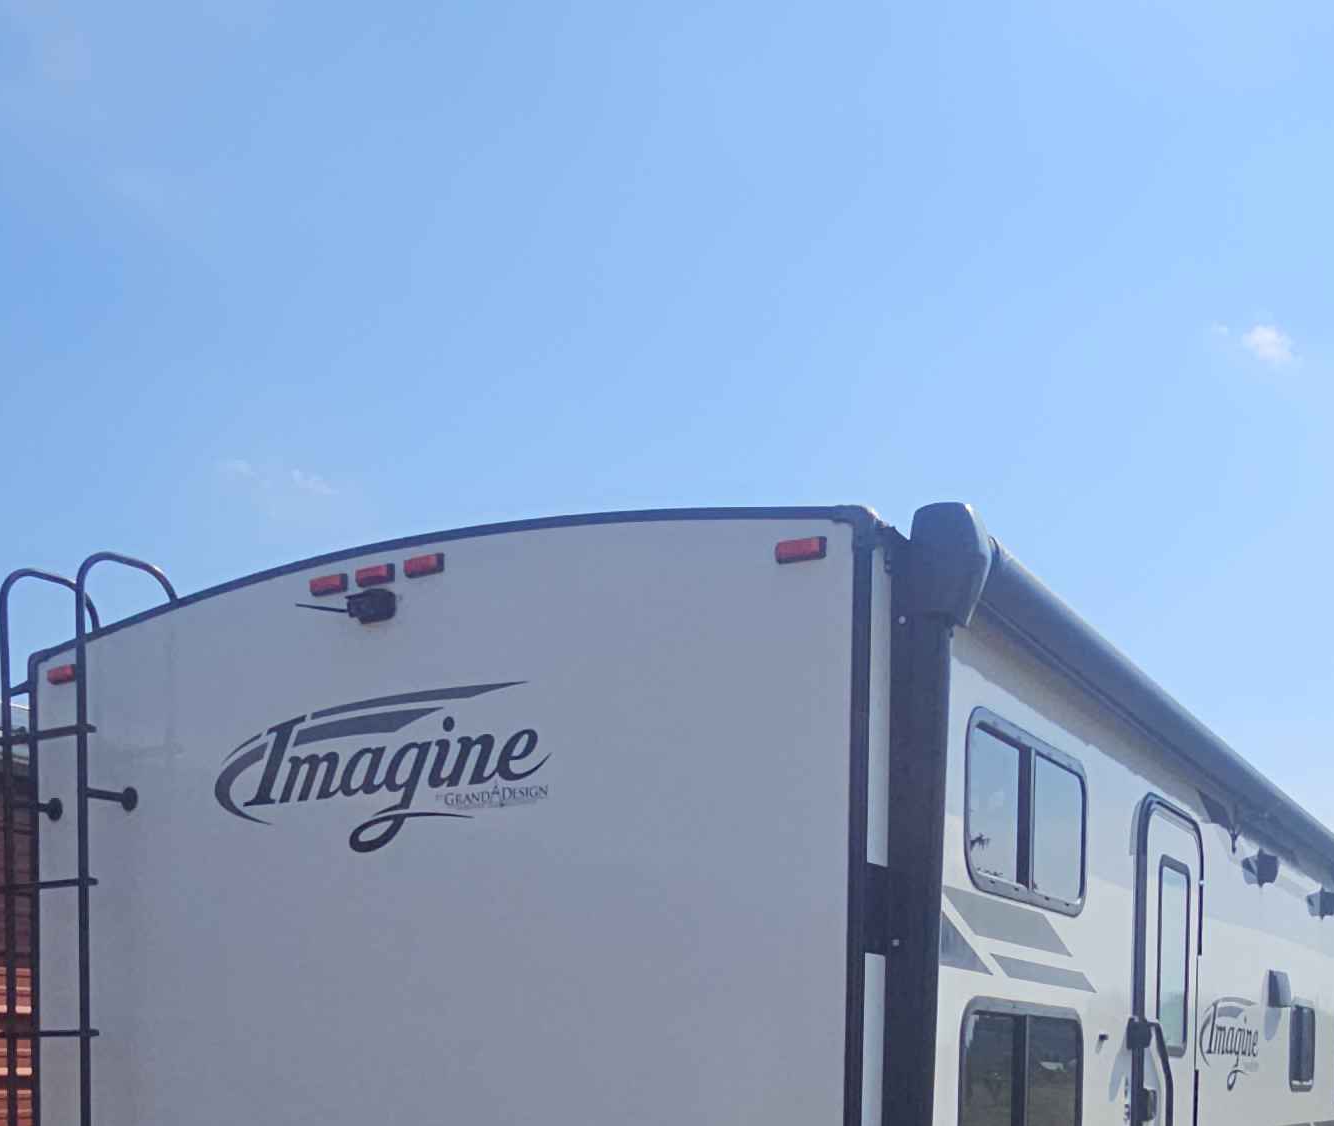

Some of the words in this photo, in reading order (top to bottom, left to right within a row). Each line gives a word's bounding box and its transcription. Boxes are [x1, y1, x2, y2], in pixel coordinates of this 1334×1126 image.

[242, 714, 552, 853] Imagine
[444, 790, 490, 806] GRAND
[1205, 1003, 1260, 1092] Imagine
